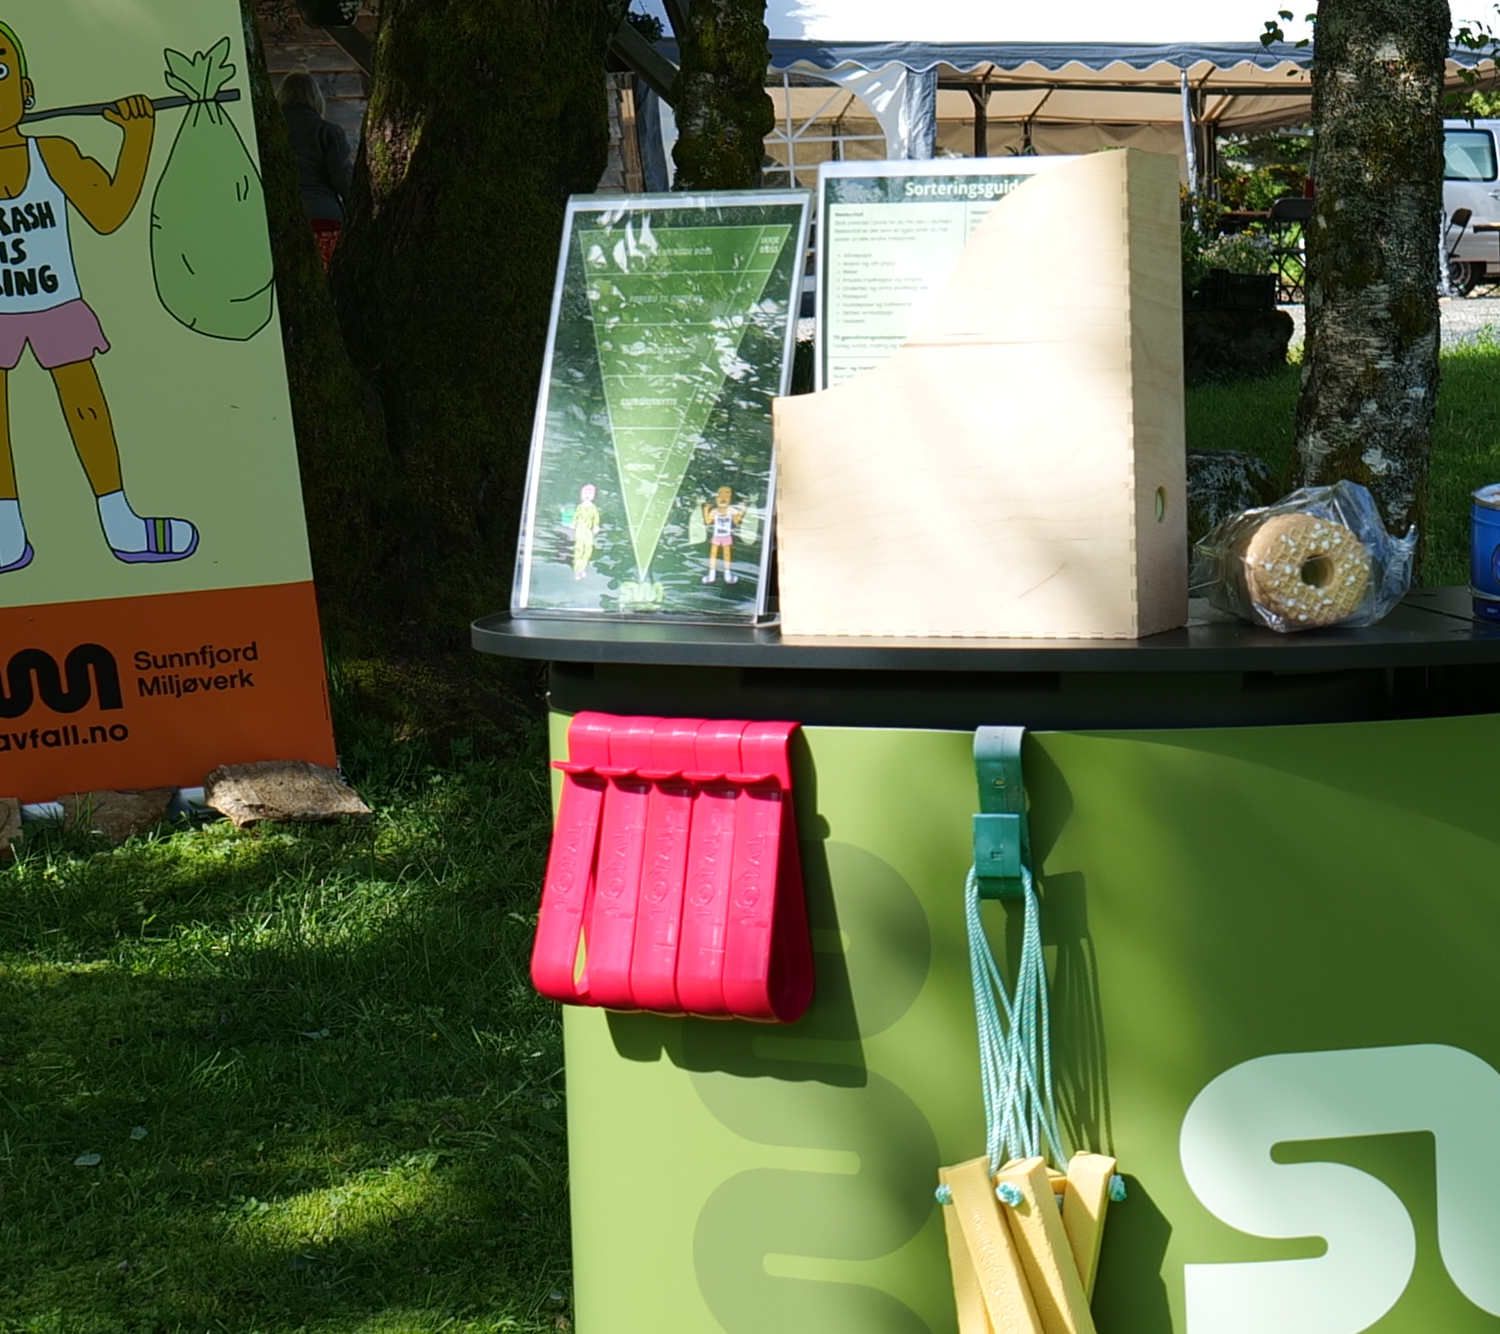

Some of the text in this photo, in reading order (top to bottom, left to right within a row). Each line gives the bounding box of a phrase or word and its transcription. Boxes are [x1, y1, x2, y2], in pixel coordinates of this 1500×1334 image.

[905, 179, 1019, 198] Sorteringsguid
[133, 641, 259, 672] Sunnfjord
[137, 668, 255, 699] Miljøverk
